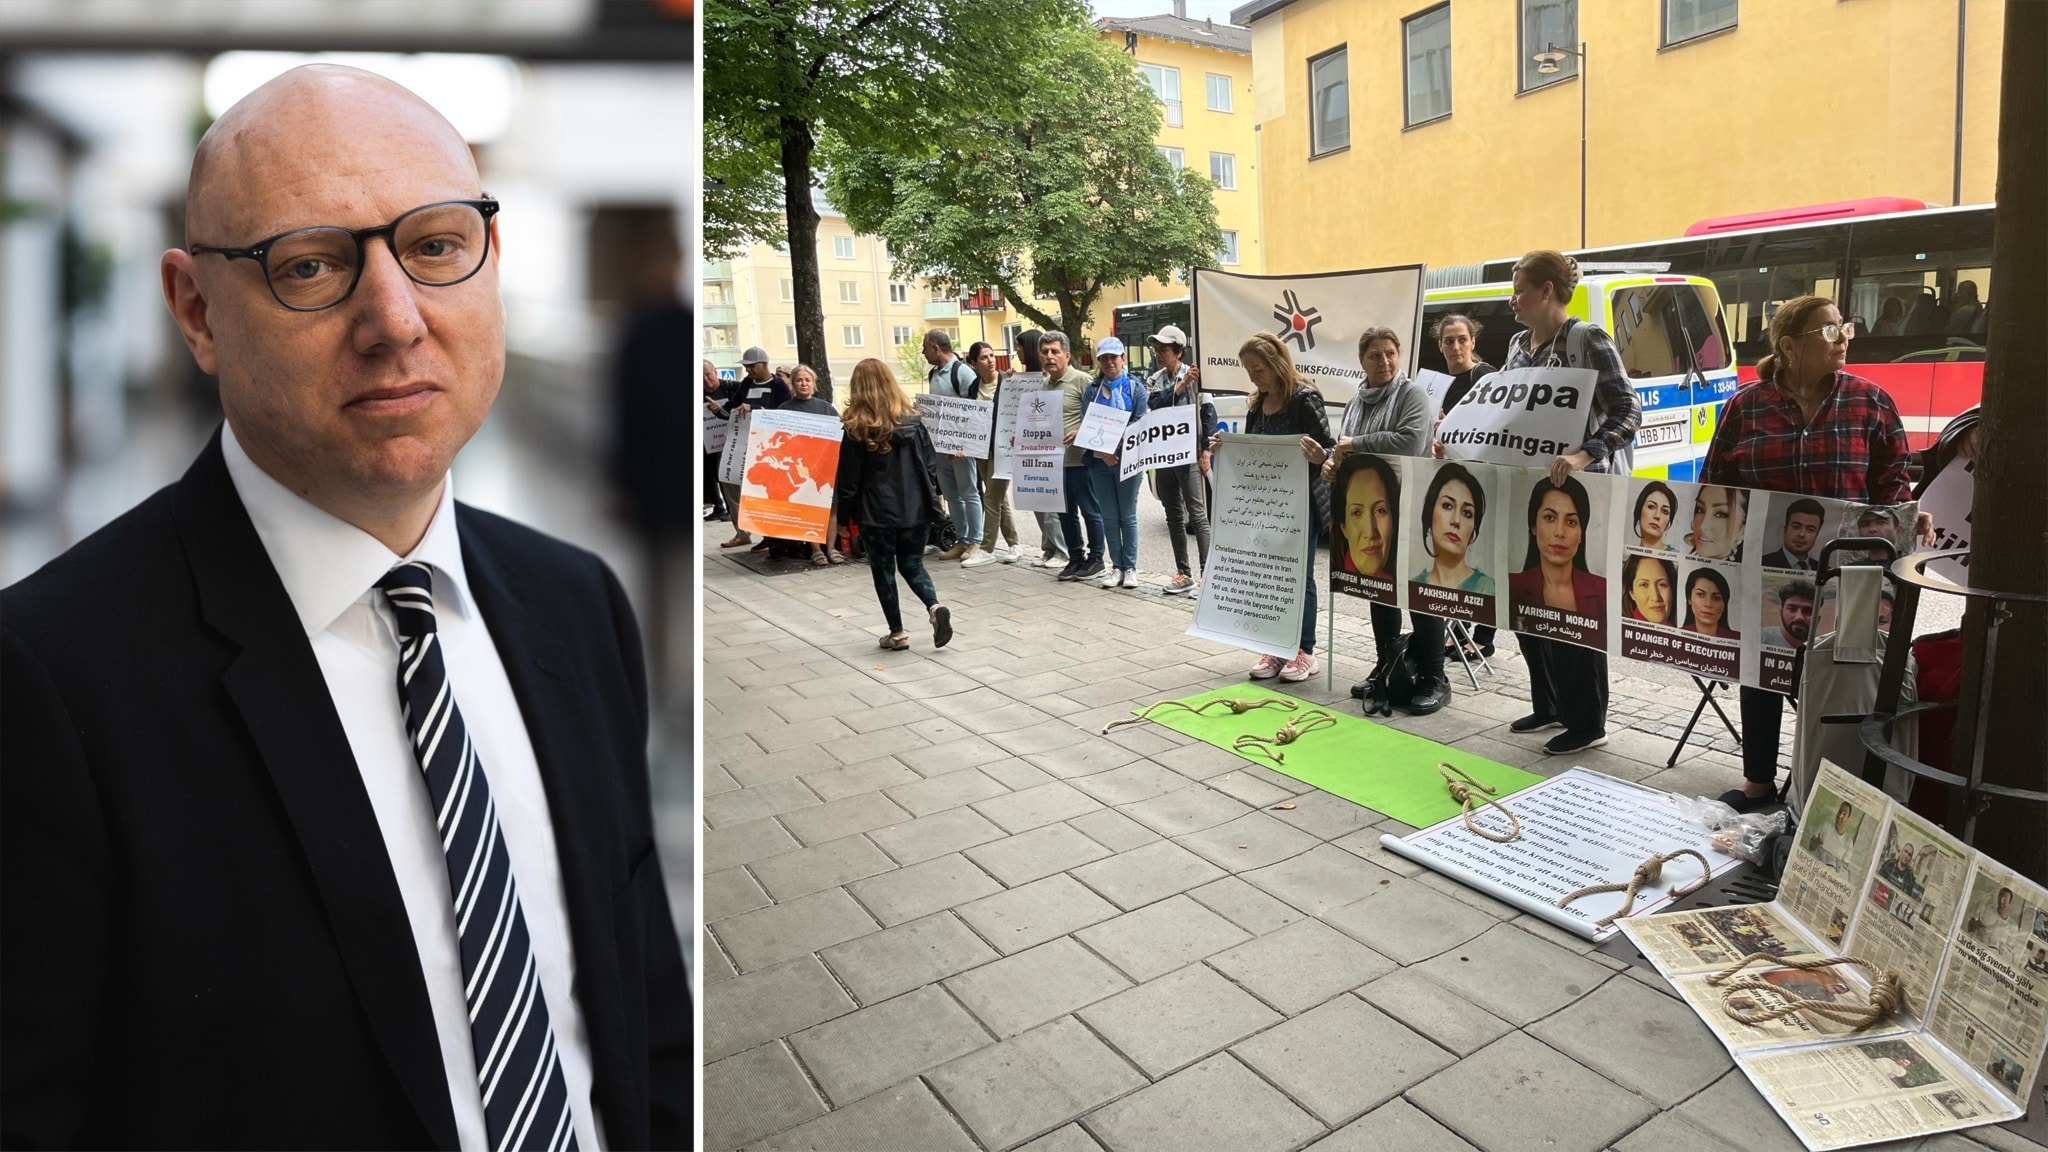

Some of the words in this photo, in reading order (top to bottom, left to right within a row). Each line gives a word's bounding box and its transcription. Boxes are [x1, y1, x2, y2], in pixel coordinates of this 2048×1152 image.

[1208, 357, 1240, 368] IRANSKA
[918, 398, 935, 406] Stoppa
[937, 400, 977, 412] utvisningen
[1460, 381, 1580, 411] Stoppa
[936, 426, 977, 439] deportation
[1022, 429, 1052, 440] Stoppa
[1126, 422, 1190, 451] Stoppa
[1440, 427, 1570, 456] utvisningar
[1640, 428, 1658, 444] HBB
[1661, 426, 1678, 440] 77Y
[1123, 450, 1190, 475] utvisningar
[1045, 487, 1058, 495] asyl
[1215, 545, 1236, 554] Christian
[1237, 549, 1257, 558] converts
[1268, 554, 1298, 563] persecuted
[1231, 567, 1249, 575] Sweden
[1250, 570, 1261, 579] they
[1245, 560, 1273, 570] authorities
[1213, 574, 1232, 583] distrust
[1249, 580, 1274, 590] Migration
[1276, 584, 1295, 593] Board.
[1331, 570, 1358, 584] SHARIFEH
[1360, 577, 1393, 592] MOHAMADI
[1280, 596, 1294, 605] right
[1419, 586, 1459, 602] PAKHSHAN
[1464, 595, 1484, 606] AZIZI
[1244, 610, 1280, 622] persecution?
[1252, 600, 1273, 611] beyond
[1274, 604, 1287, 614] fear,
[1429, 602, 1448, 612] عزیزی
[1450, 605, 1473, 618] پخشان
[1518, 604, 1560, 621] VARISHEH
[1566, 613, 1598, 630] MORADI
[1536, 622, 1557, 633] مرادی
[1559, 627, 1582, 640] وریشه
[1625, 629, 1632, 639] IN
[1636, 632, 1669, 646] DANGER
[1672, 640, 1682, 649] OF
[1684, 642, 1735, 661] EXECUTION
[1630, 646, 1648, 656] اعدام
[1649, 650, 1664, 659] خطر
[1675, 658, 1699, 668] سیاسی
[1764, 657, 1775, 668] IN
[1700, 664, 1728, 676] زندانیان
[1770, 676, 1792, 686] اعدام
[1551, 786, 1569, 795] Jag
[1570, 792, 1597, 803] heter
[1563, 781, 1581, 790] Jag
[1594, 790, 1623, 802] också
[1528, 806, 1547, 816] jag
[1546, 811, 1600, 835] återvänder
[1600, 832, 1615, 841] till
[1542, 801, 1575, 816] religiös
[1575, 814, 1615, 829] politisk
[1615, 827, 1655, 842] aktivist
[1553, 794, 1586, 809] kristen
[1586, 805, 1632, 824] konvertit
[1632, 822, 1700, 847] asylsökande
[1485, 813, 1505, 823] rätta
[1527, 828, 1570, 848] fängslas.
[1515, 813, 1529, 821] att
[1528, 818, 1579, 840] arresteras,
[1582, 837, 1616, 852] ställas
[1426, 835, 1443, 847] mig
[1445, 843, 1464, 854] och
[1465, 851, 1495, 868] hjälpa
[1495, 864, 1515, 875] mig
[1516, 871, 1537, 882] och
[1442, 830, 1458, 839] Det
[1470, 840, 1489, 850] min
[1490, 848, 1533, 869] begäran:
[1535, 867, 1551, 875] att
[1552, 872, 1586, 889] stödja
[1505, 843, 1528, 854] som
[1529, 852, 1566, 869] kristen
[1572, 868, 1595, 879] mitt
[1529, 840, 1554, 852] mina
[1556, 850, 1610, 872] mänskliga
[1474, 869, 1501, 882] svåra
[1956, 933, 1976, 951] Lärde
[1976, 948, 1988, 961] sig
[1987, 956, 2015, 979] svenska
[2015, 975, 2034, 991] själv
[2015, 987, 2038, 1007] andra
